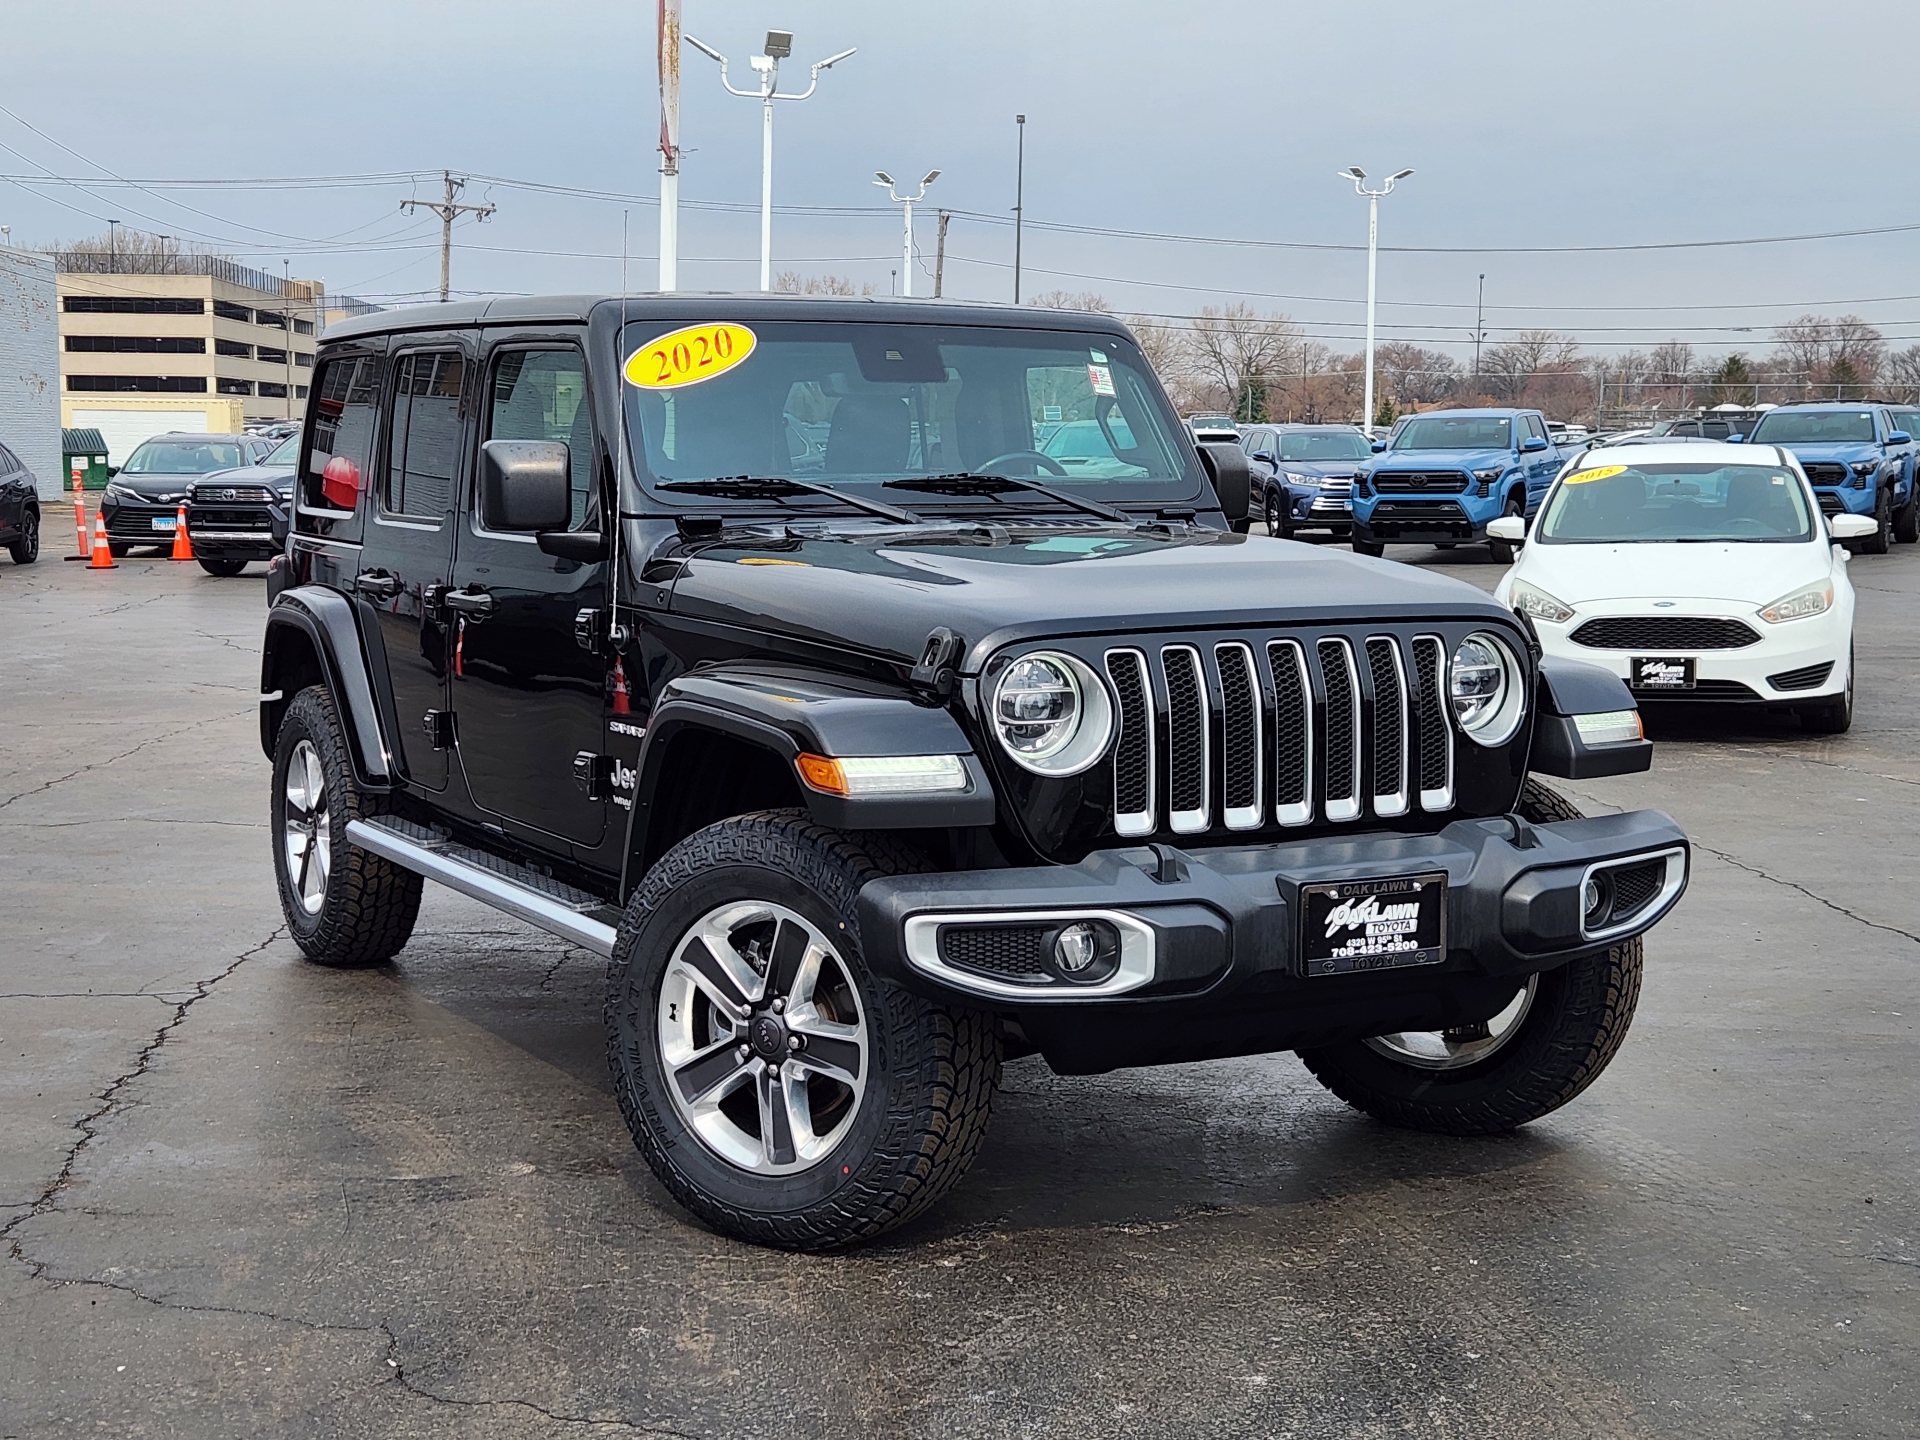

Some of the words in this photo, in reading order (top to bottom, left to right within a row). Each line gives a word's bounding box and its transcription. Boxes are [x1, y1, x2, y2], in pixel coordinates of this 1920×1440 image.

[650, 327, 733, 383] 2020
[1575, 466, 1613, 482] 2015
[610, 759, 637, 790] Jee
[1343, 884, 1370, 896] OAK
[1373, 881, 1408, 893] LAWN
[1371, 921, 1412, 933] TOYOTA
[1331, 940, 1419, 958] 708-423-5200
[1346, 937, 1366, 947] 4320
[1367, 936, 1376, 945] W
[1350, 954, 1401, 969] TOYOTA
[625, 978, 642, 1033] A/T
[627, 1039, 678, 1151] PREVAIL
